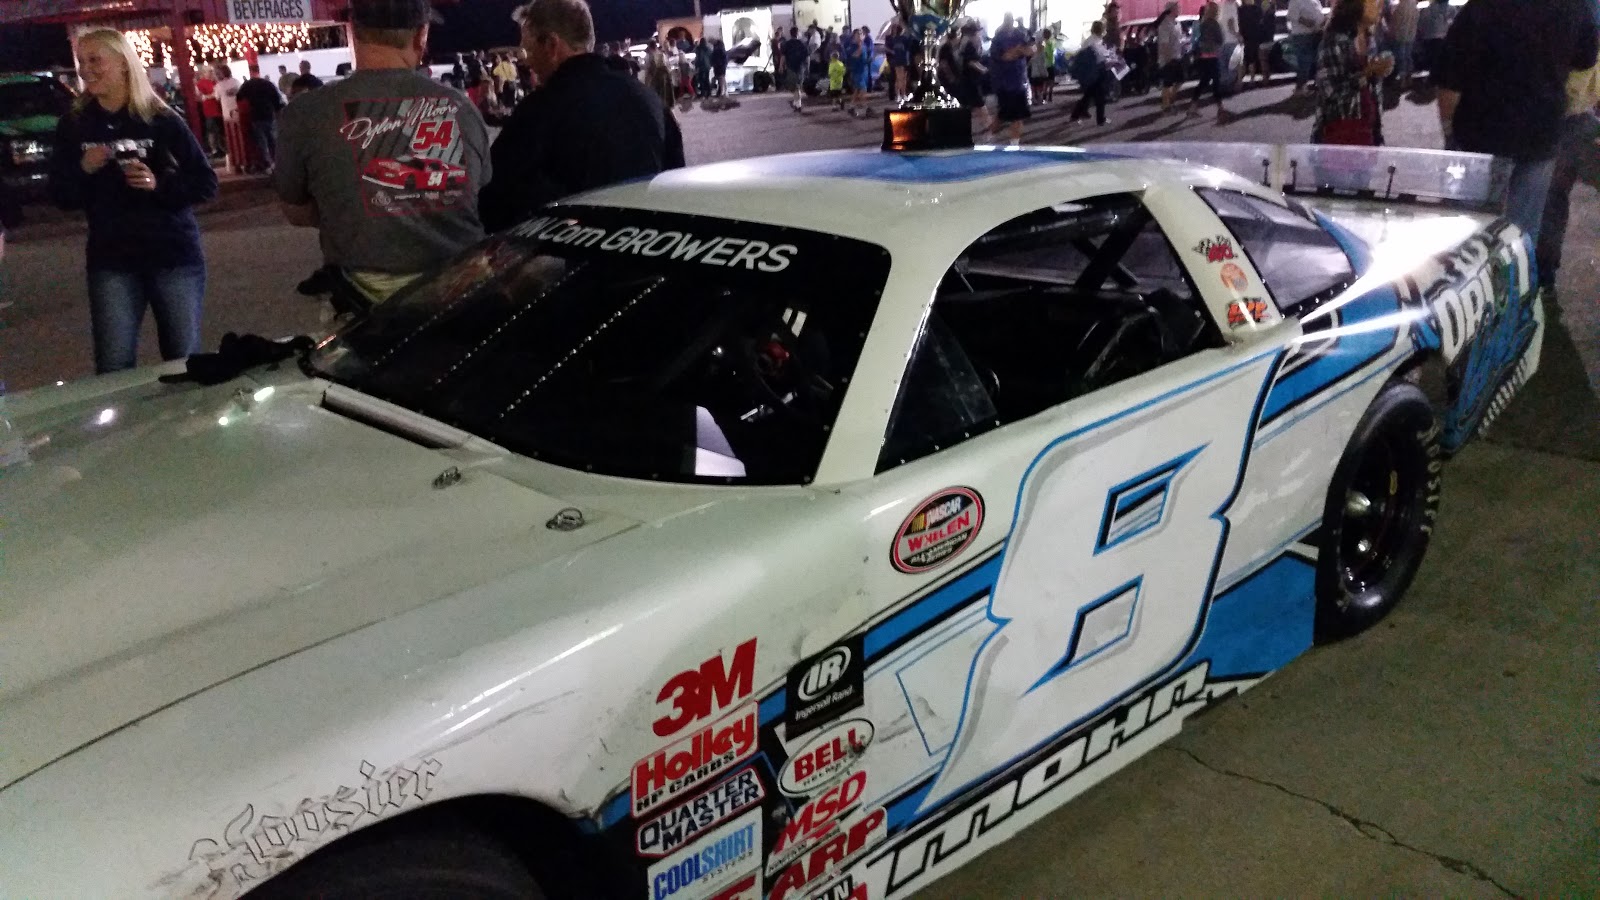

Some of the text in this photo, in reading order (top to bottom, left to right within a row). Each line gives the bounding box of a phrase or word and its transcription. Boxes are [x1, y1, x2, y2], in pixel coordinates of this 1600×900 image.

[233, 0, 304, 19] BEVERAGES
[340, 97, 458, 149] Dylan Moore
[412, 119, 455, 151] 54
[600, 227, 798, 272] GROWERS
[926, 496, 961, 532] NASCAR
[917, 345, 1290, 812] 8
[653, 637, 757, 736] 3M
[807, 654, 843, 694] IR
[636, 713, 755, 801] Holley
[794, 728, 863, 782] BELL
[640, 770, 753, 850] QUARTER
[663, 783, 760, 853] MASTER
[774, 770, 867, 855] MSD
[768, 808, 885, 900] ARP
